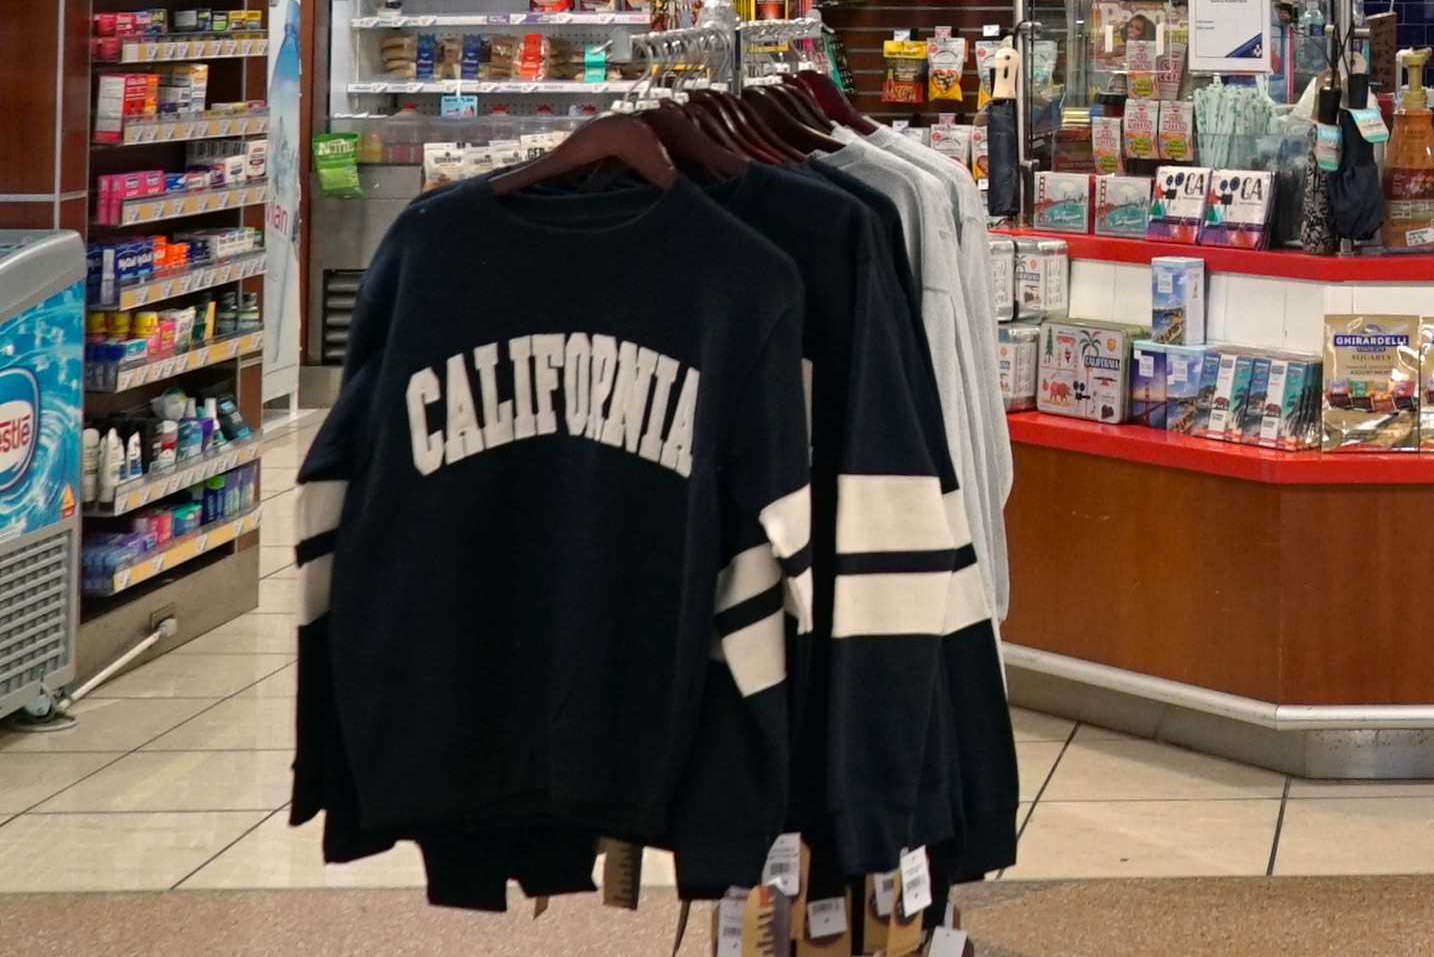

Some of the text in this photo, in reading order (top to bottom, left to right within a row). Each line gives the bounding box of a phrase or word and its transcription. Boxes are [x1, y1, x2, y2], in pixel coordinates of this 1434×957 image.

[1184, 172, 1204, 196] CA
[1241, 177, 1264, 201] CA
[1336, 336, 1407, 345] GHIRARDELLI
[406, 332, 700, 478] CALIFORNIA
